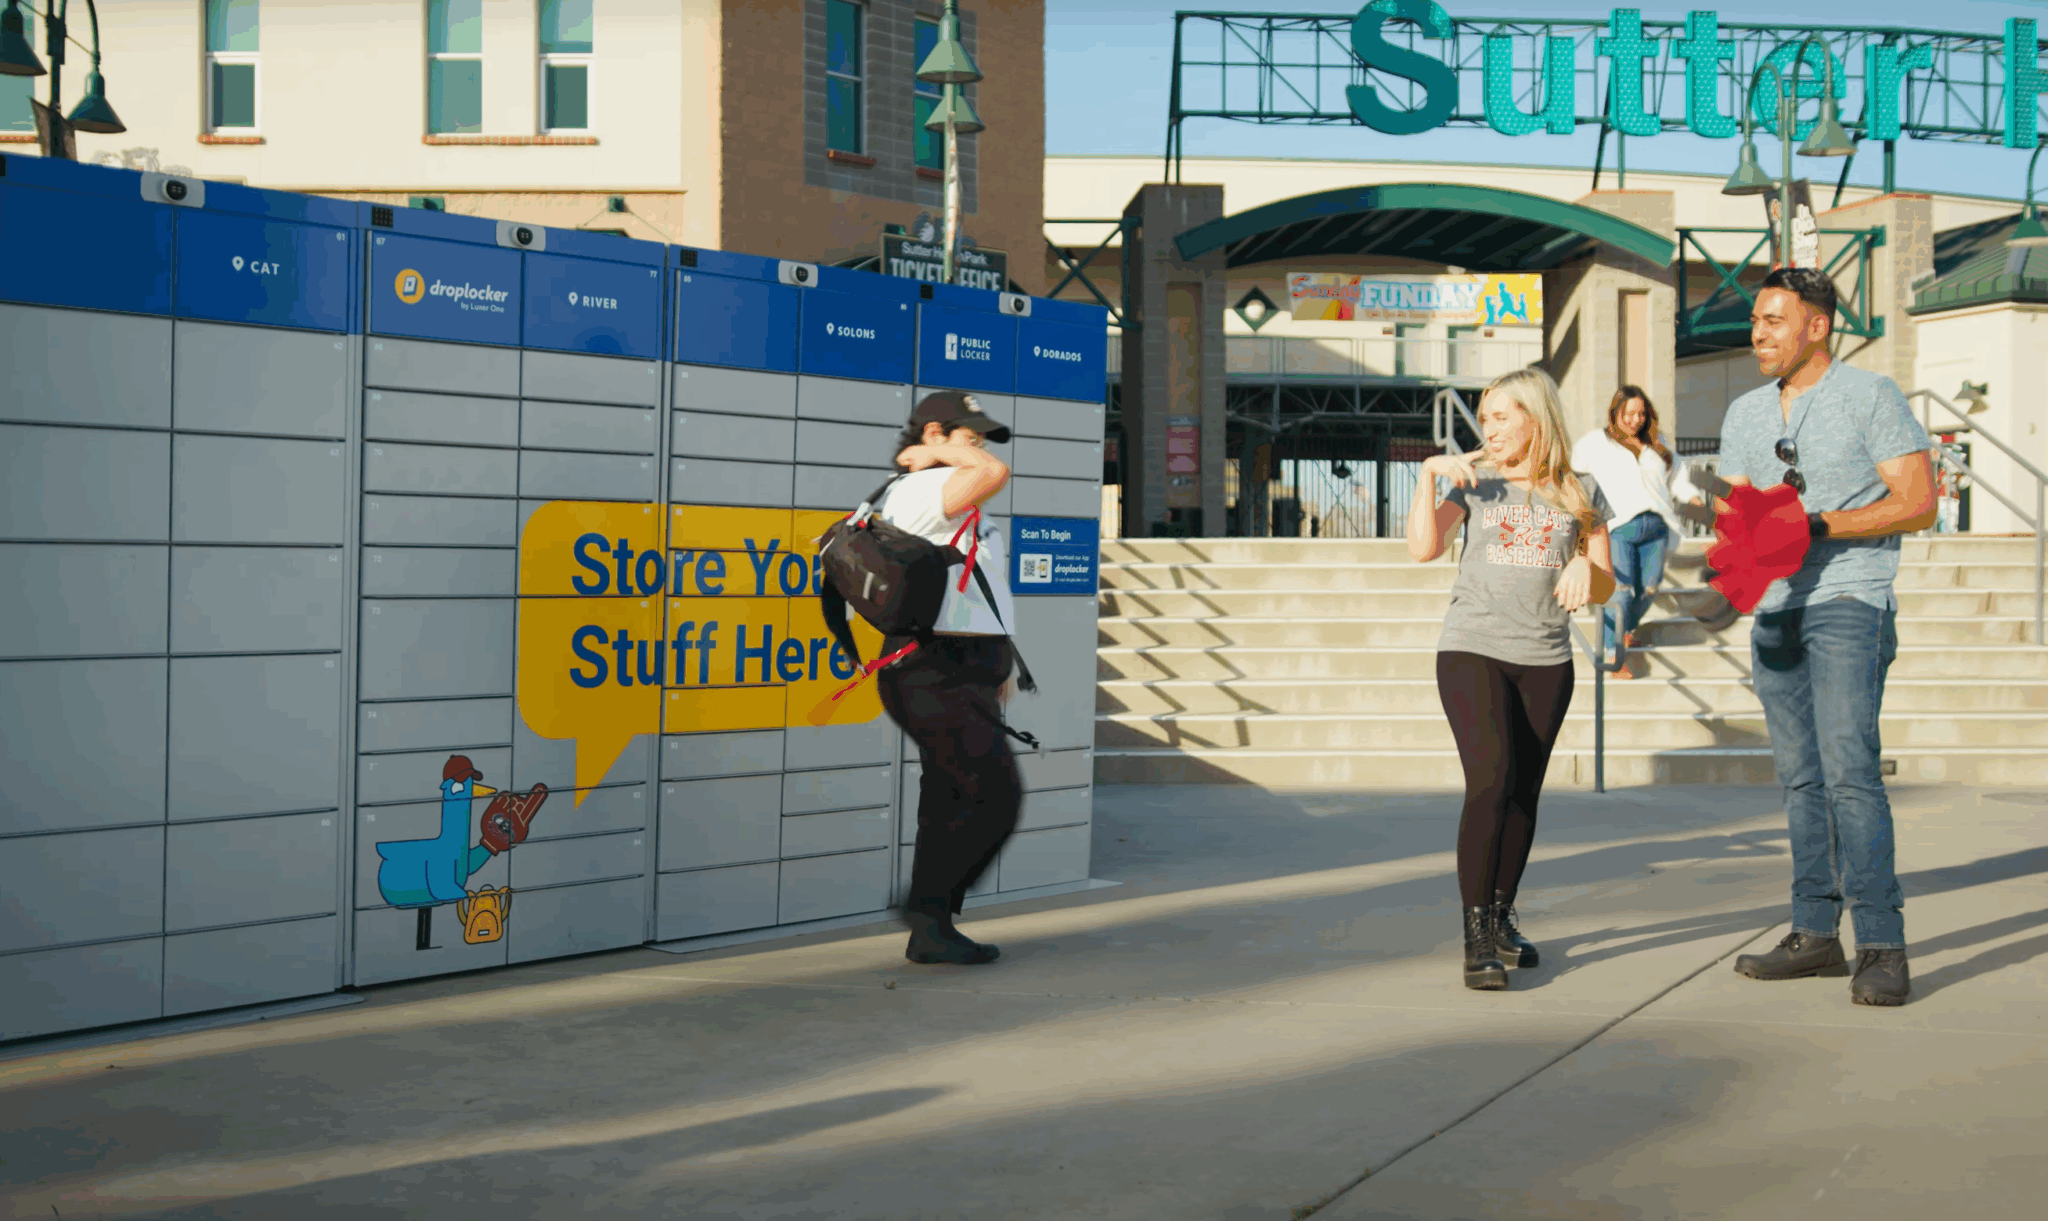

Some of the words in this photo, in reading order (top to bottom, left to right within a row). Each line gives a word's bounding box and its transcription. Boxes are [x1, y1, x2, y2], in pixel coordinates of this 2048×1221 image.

[1346, 0, 1932, 139] Sutter
[901, 241, 932, 257] Sutter
[964, 251, 989, 266] Park
[250, 260, 280, 276] CAT
[889, 258, 945, 283] TICKET
[960, 267, 1001, 291] FFICE
[429, 279, 508, 303] droplocker
[1291, 275, 1360, 303] Sunday
[1360, 280, 1485, 310] FUNDAY
[460, 302, 469, 312] by
[490, 304, 505, 314] One
[582, 295, 618, 310] RIVER
[838, 326, 876, 340] SOLONS
[961, 337, 991, 350] PUBLIC
[960, 350, 991, 361] LOCKER
[1042, 348, 1082, 362] DORADOS
[1482, 504, 1533, 529] RIVER
[1021, 528, 1040, 539] Scan
[1041, 529, 1050, 540] To
[1051, 530, 1072, 542] Begin
[571, 532, 726, 595] Store
[743, 538, 822, 595] Yo
[1486, 544, 1562, 569] BASEBALL
[1054, 563, 1089, 576] droplocker
[569, 620, 718, 688] Stuff
[735, 624, 856, 683] Here
